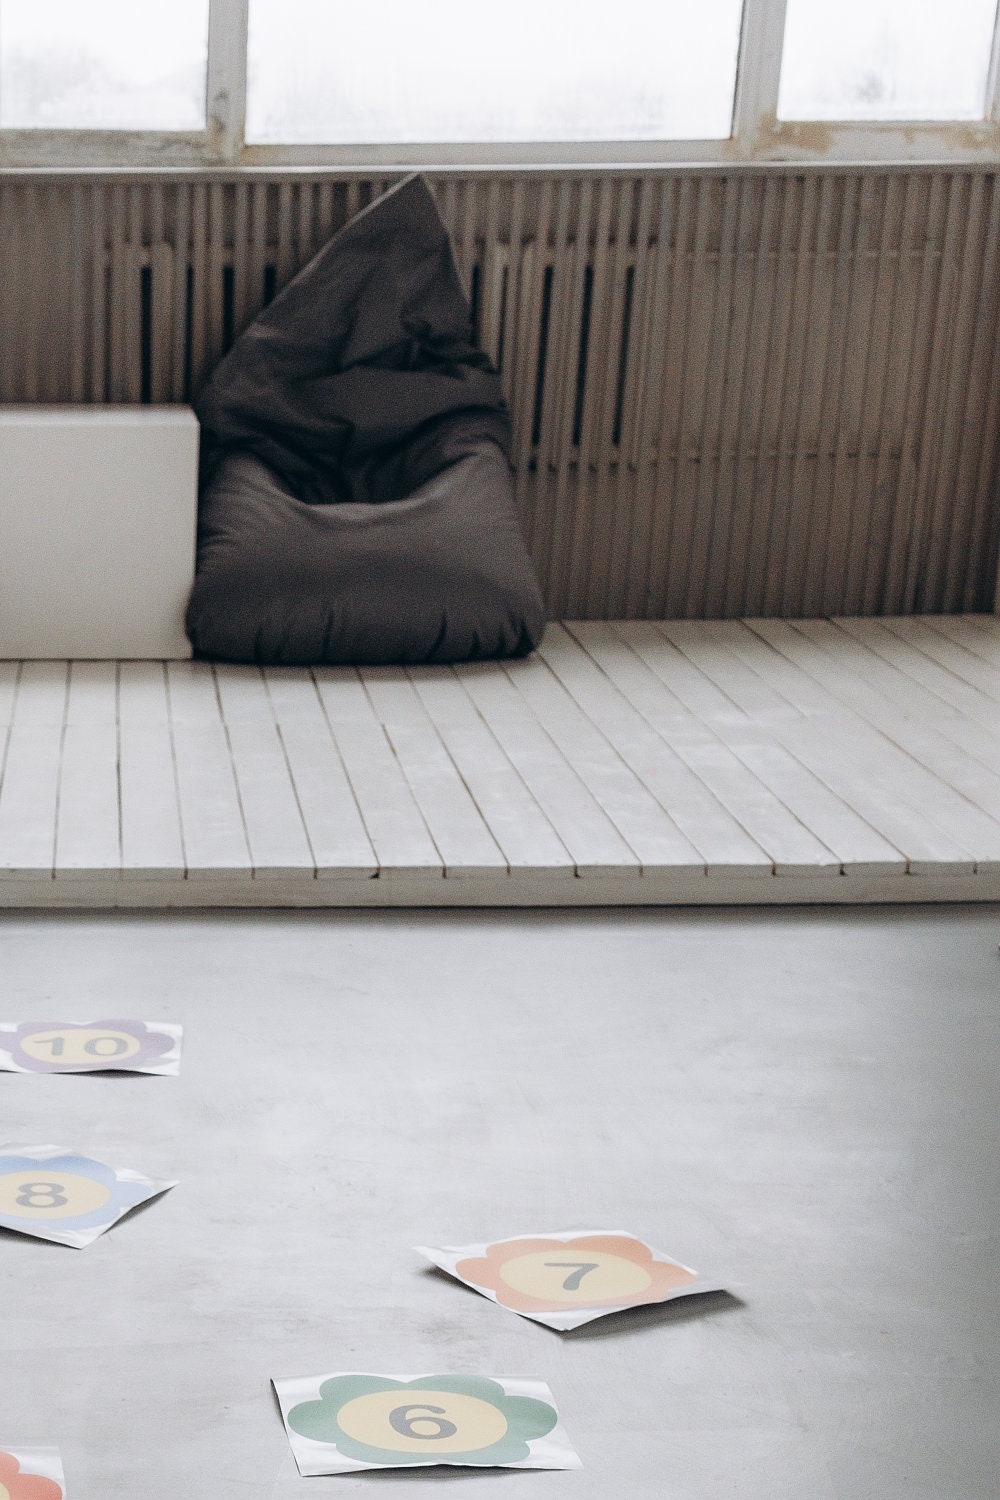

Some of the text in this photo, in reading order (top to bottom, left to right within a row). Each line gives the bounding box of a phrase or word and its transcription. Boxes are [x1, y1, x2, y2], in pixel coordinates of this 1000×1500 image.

[33, 1036, 128, 1056] 10
[16, 1182, 69, 1209] 8
[544, 1263, 599, 1291] 7
[388, 1404, 458, 1441] 6
